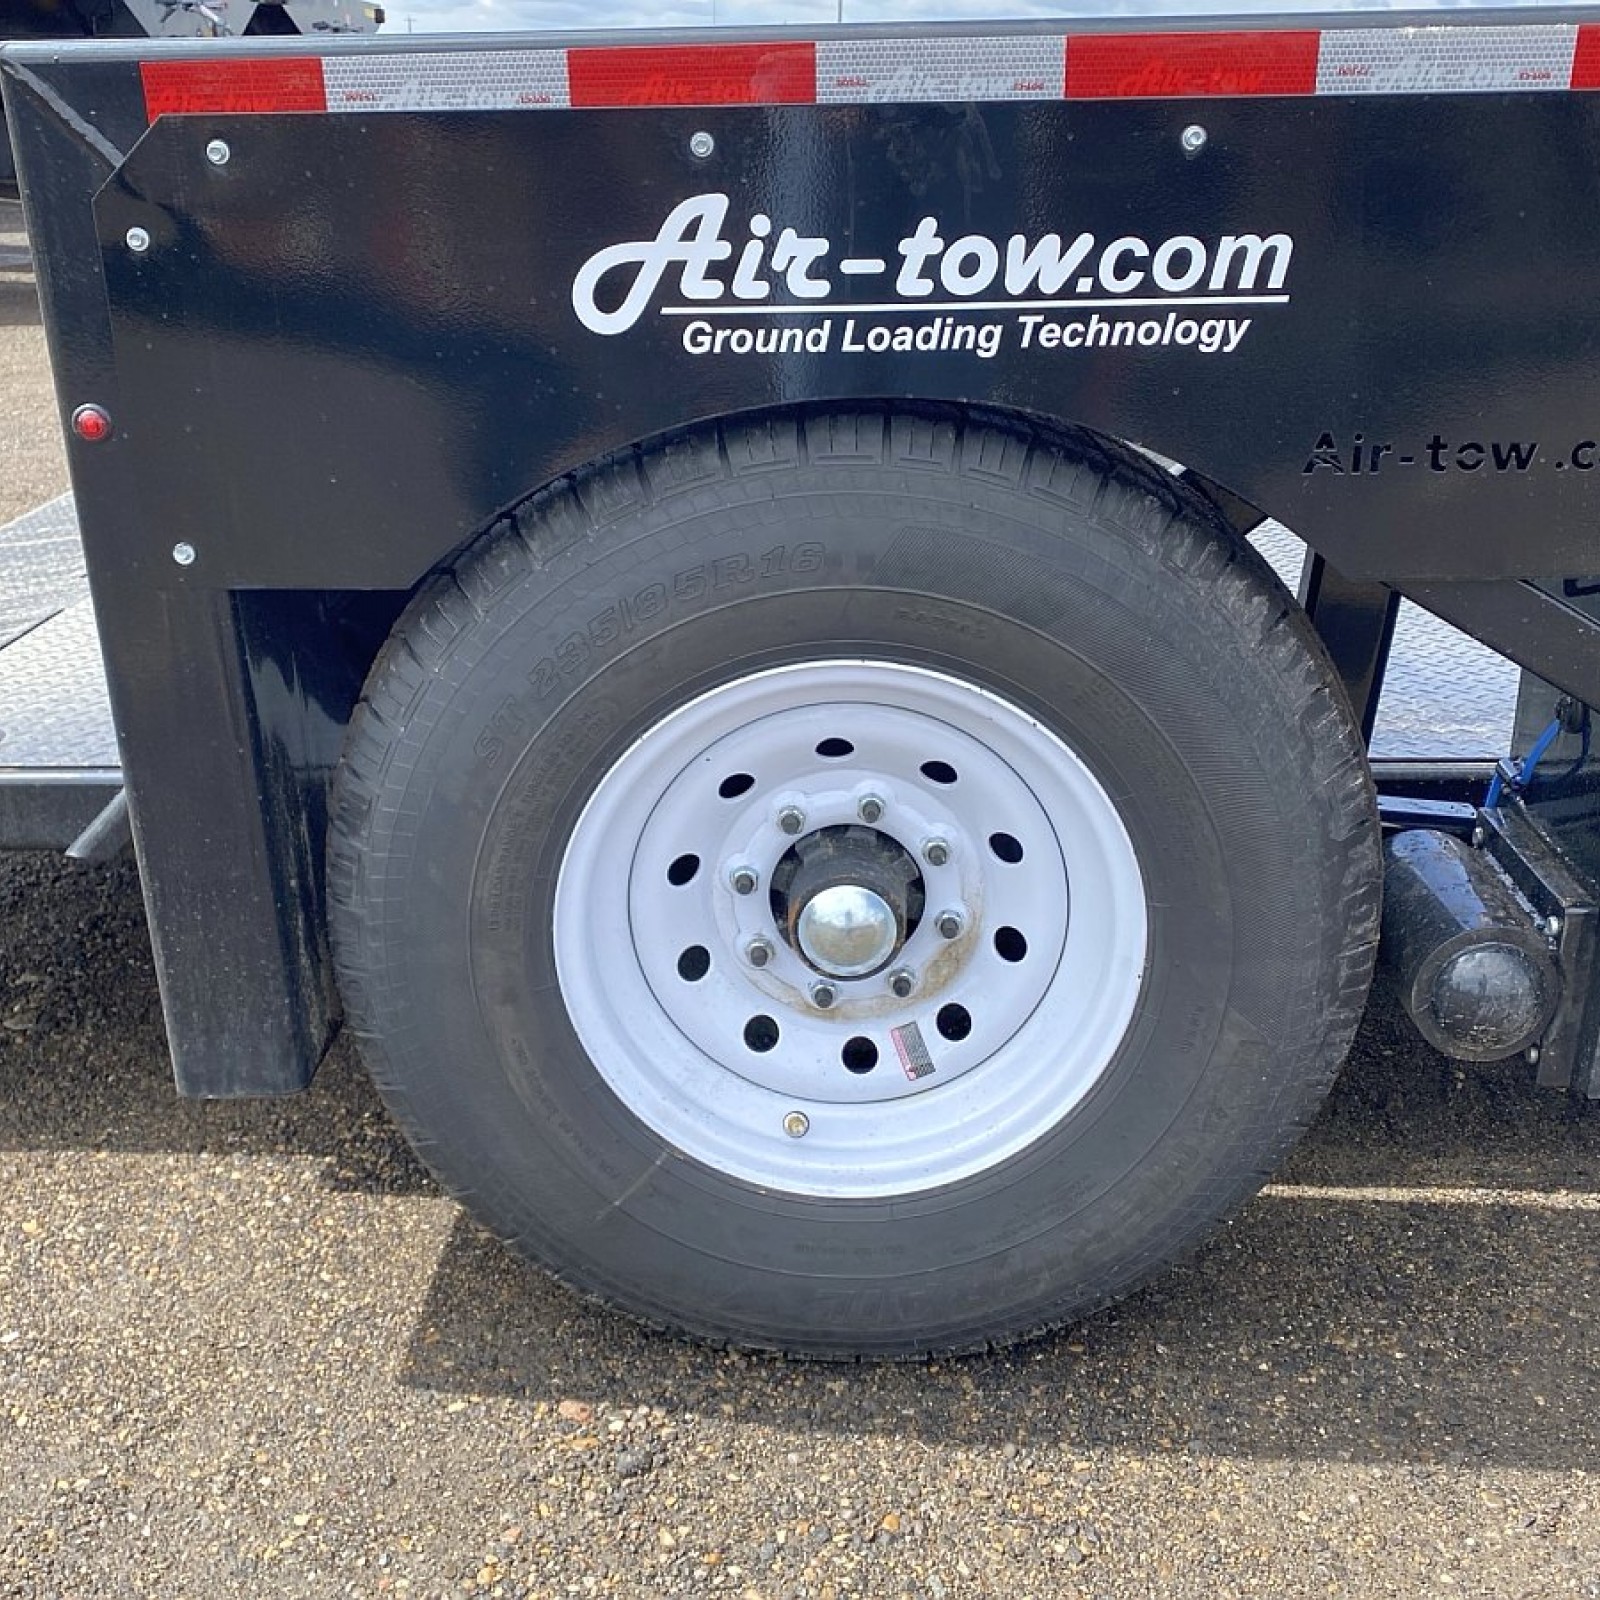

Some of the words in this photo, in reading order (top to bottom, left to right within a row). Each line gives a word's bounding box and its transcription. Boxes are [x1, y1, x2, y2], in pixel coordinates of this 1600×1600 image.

[573, 194, 1293, 335] Air-tow.com
[683, 320, 831, 355] Ground
[842, 320, 1003, 357] Loading
[1019, 313, 1251, 353] Technology
[1301, 430, 1539, 475] Air-tow
[1555, 440, 1600, 471] .c
